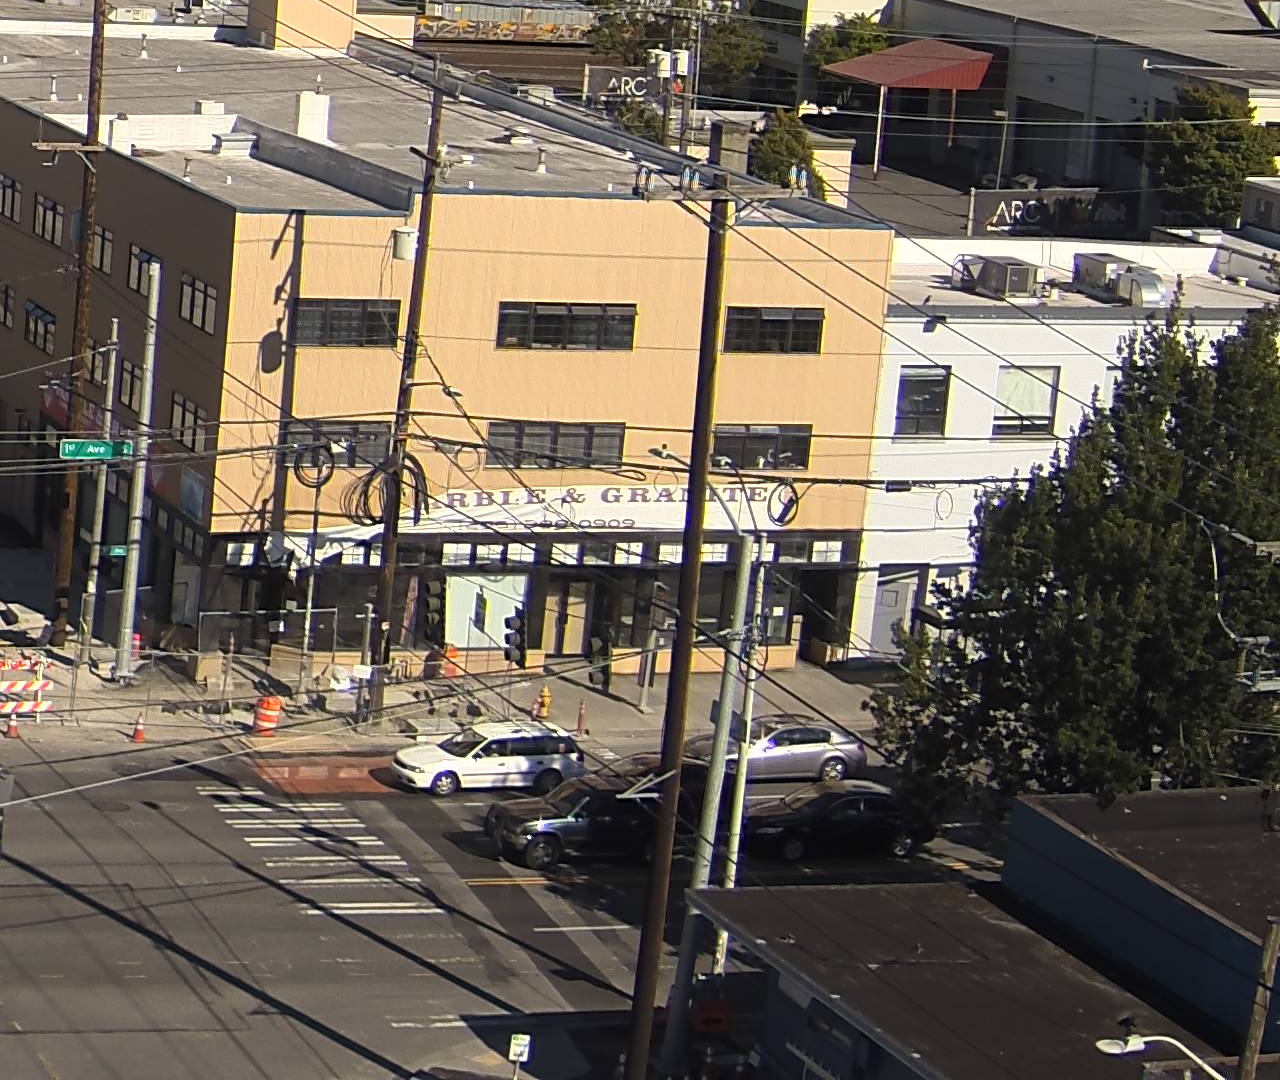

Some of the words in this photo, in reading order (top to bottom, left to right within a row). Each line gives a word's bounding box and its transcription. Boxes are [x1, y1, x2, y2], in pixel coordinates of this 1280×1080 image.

[608, 76, 647, 96] ARC
[992, 200, 1041, 224] ARC
[87, 444, 105, 454] Ave
[562, 487, 586, 503] &
